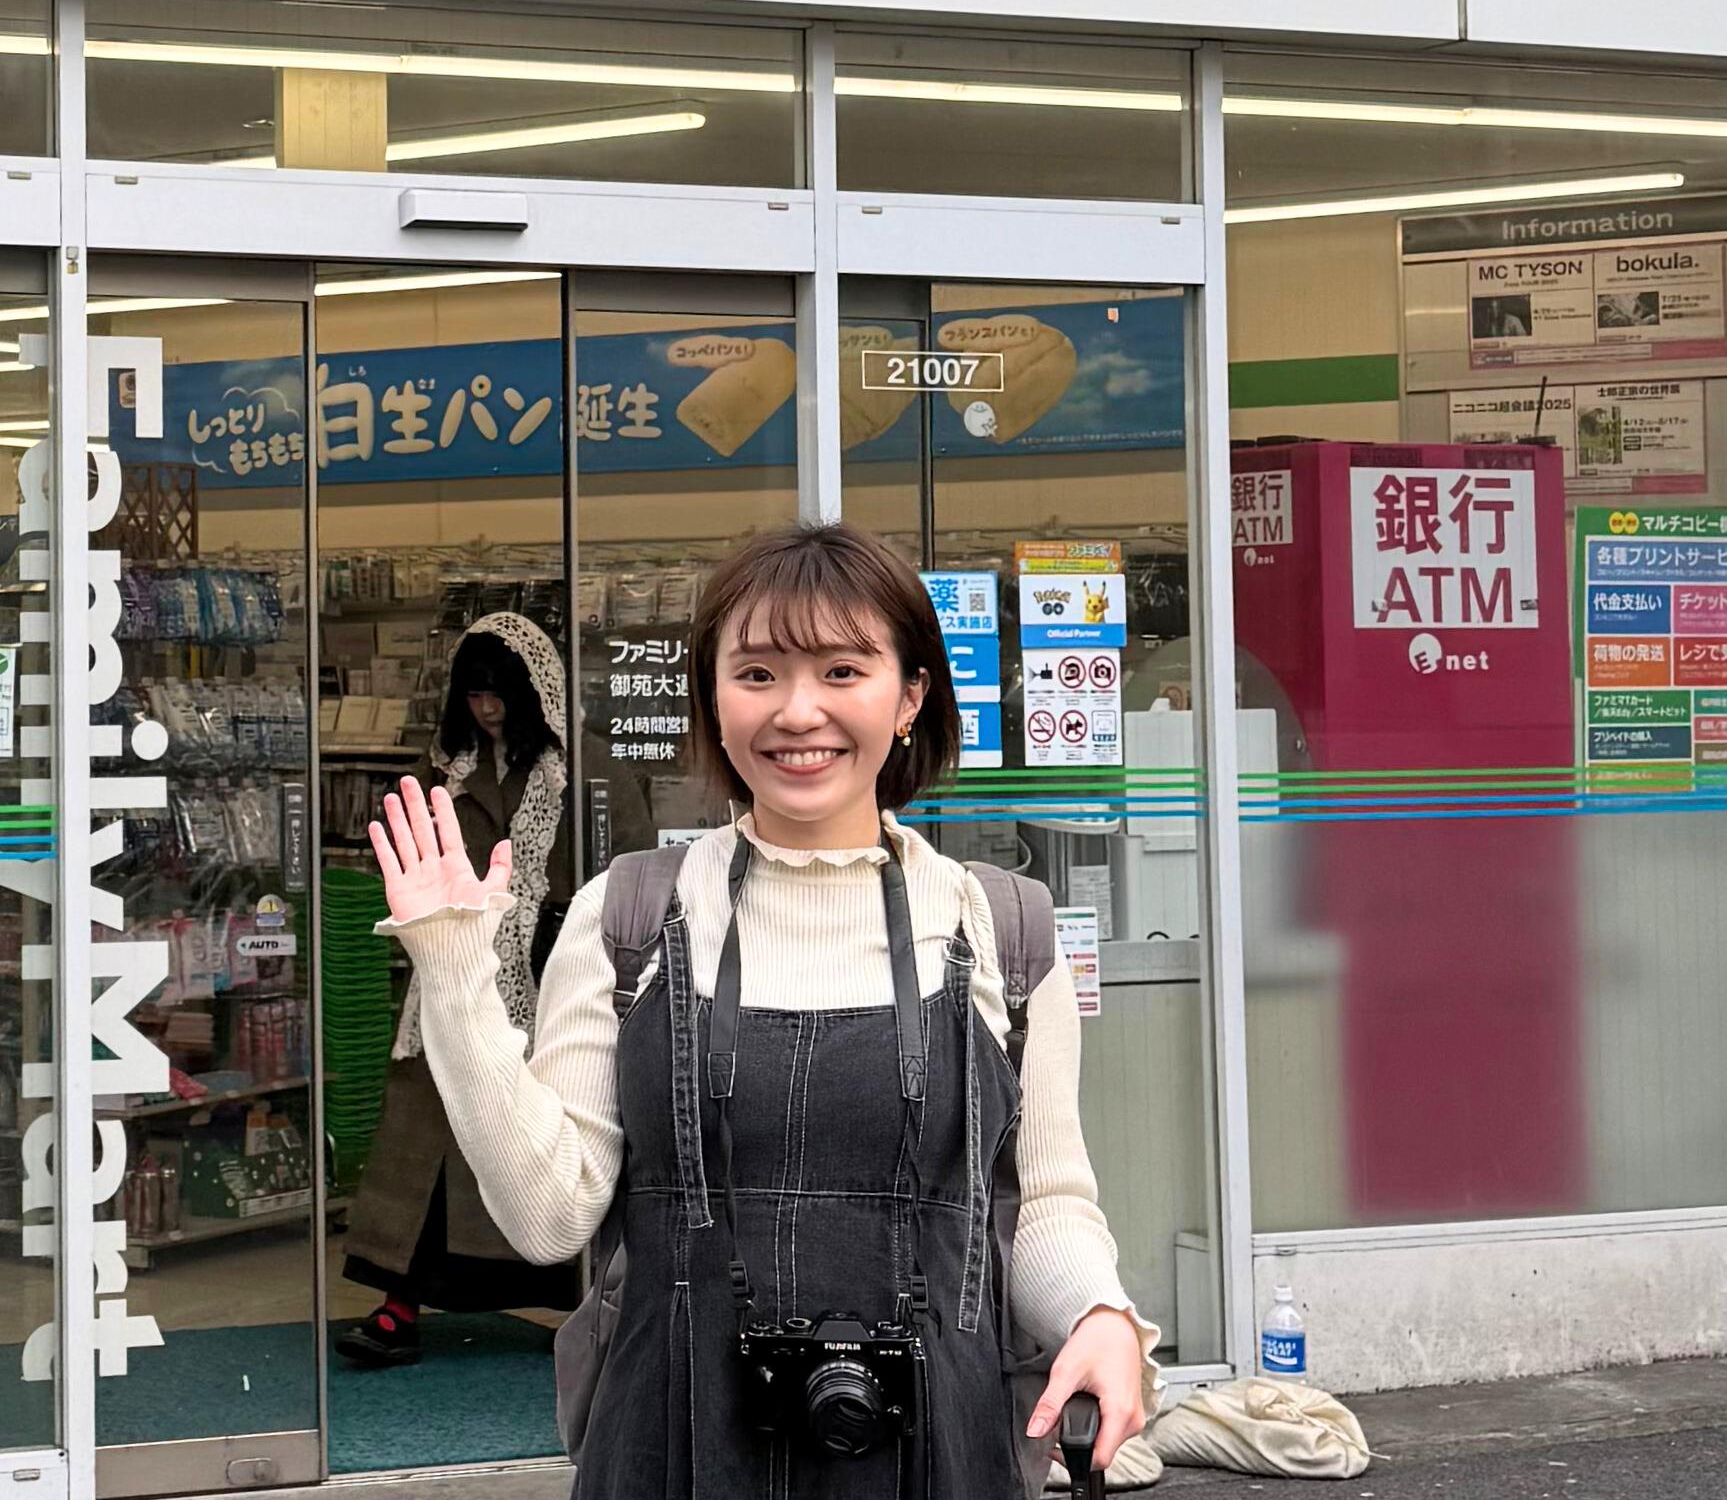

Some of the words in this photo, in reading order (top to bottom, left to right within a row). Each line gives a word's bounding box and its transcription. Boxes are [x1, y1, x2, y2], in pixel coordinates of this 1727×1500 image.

[1502, 210, 1673, 240] Information
[1479, 265, 1508, 281] MC
[1514, 260, 1583, 278] TYSON
[1616, 252, 1700, 273] bokula.
[887, 357, 980, 386] 21007
[1232, 474, 1284, 512] 銀行
[1374, 475, 1514, 555] 銀行
[1233, 516, 1284, 543] ATM
[929, 579, 960, 613] 薬
[1375, 567, 1514, 623] ATM
[1593, 593, 1663, 611] 代金支払い
[1594, 644, 1665, 662] 荷物の発送
[248, 940, 279, 950] AUTO
